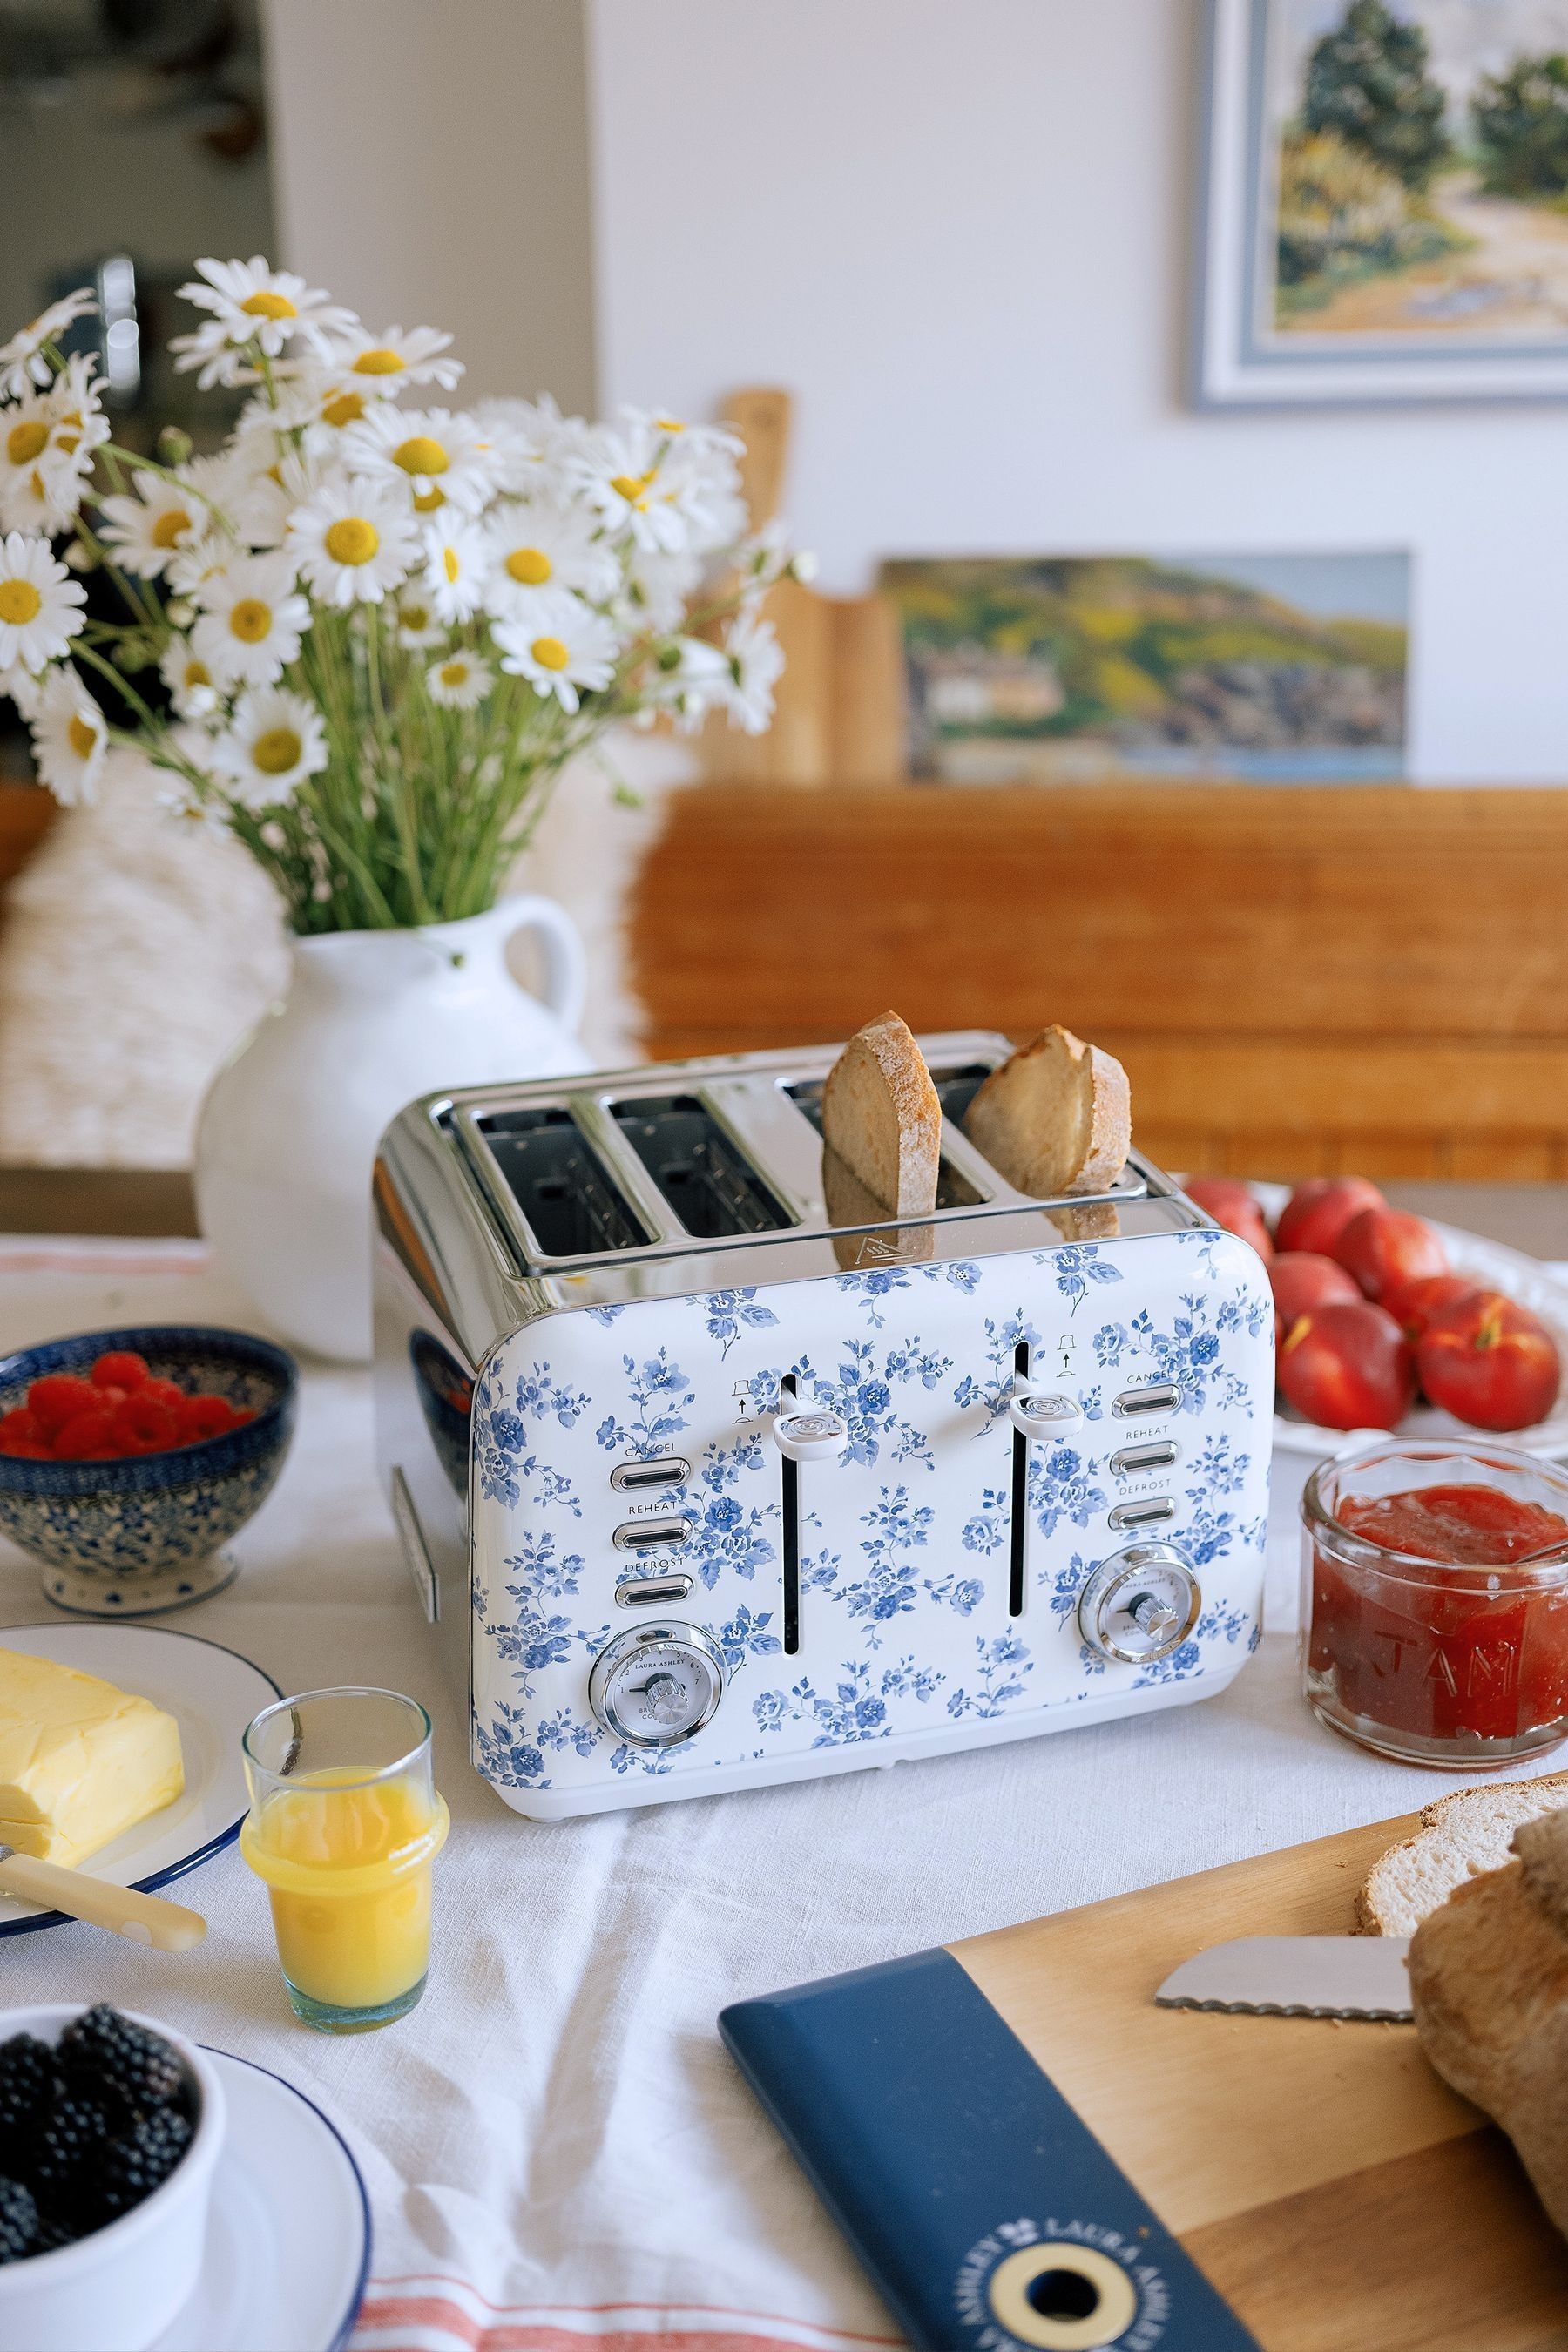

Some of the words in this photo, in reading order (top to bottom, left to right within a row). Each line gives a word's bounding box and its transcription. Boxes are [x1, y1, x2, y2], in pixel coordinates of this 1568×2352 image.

[1126, 1369, 1172, 1384] CANCEL
[1125, 1424, 1169, 1440] REHEAT
[625, 1443, 678, 1457] CANCEL
[1119, 1478, 1171, 1496] DEFROST
[628, 1501, 676, 1515] REHEAT
[625, 1556, 686, 1573] DEFROST
[659, 1659, 686, 1667] ASHLEY
[1370, 1629, 1517, 1699] JAM
[1045, 2217, 1142, 2264] LAURA
